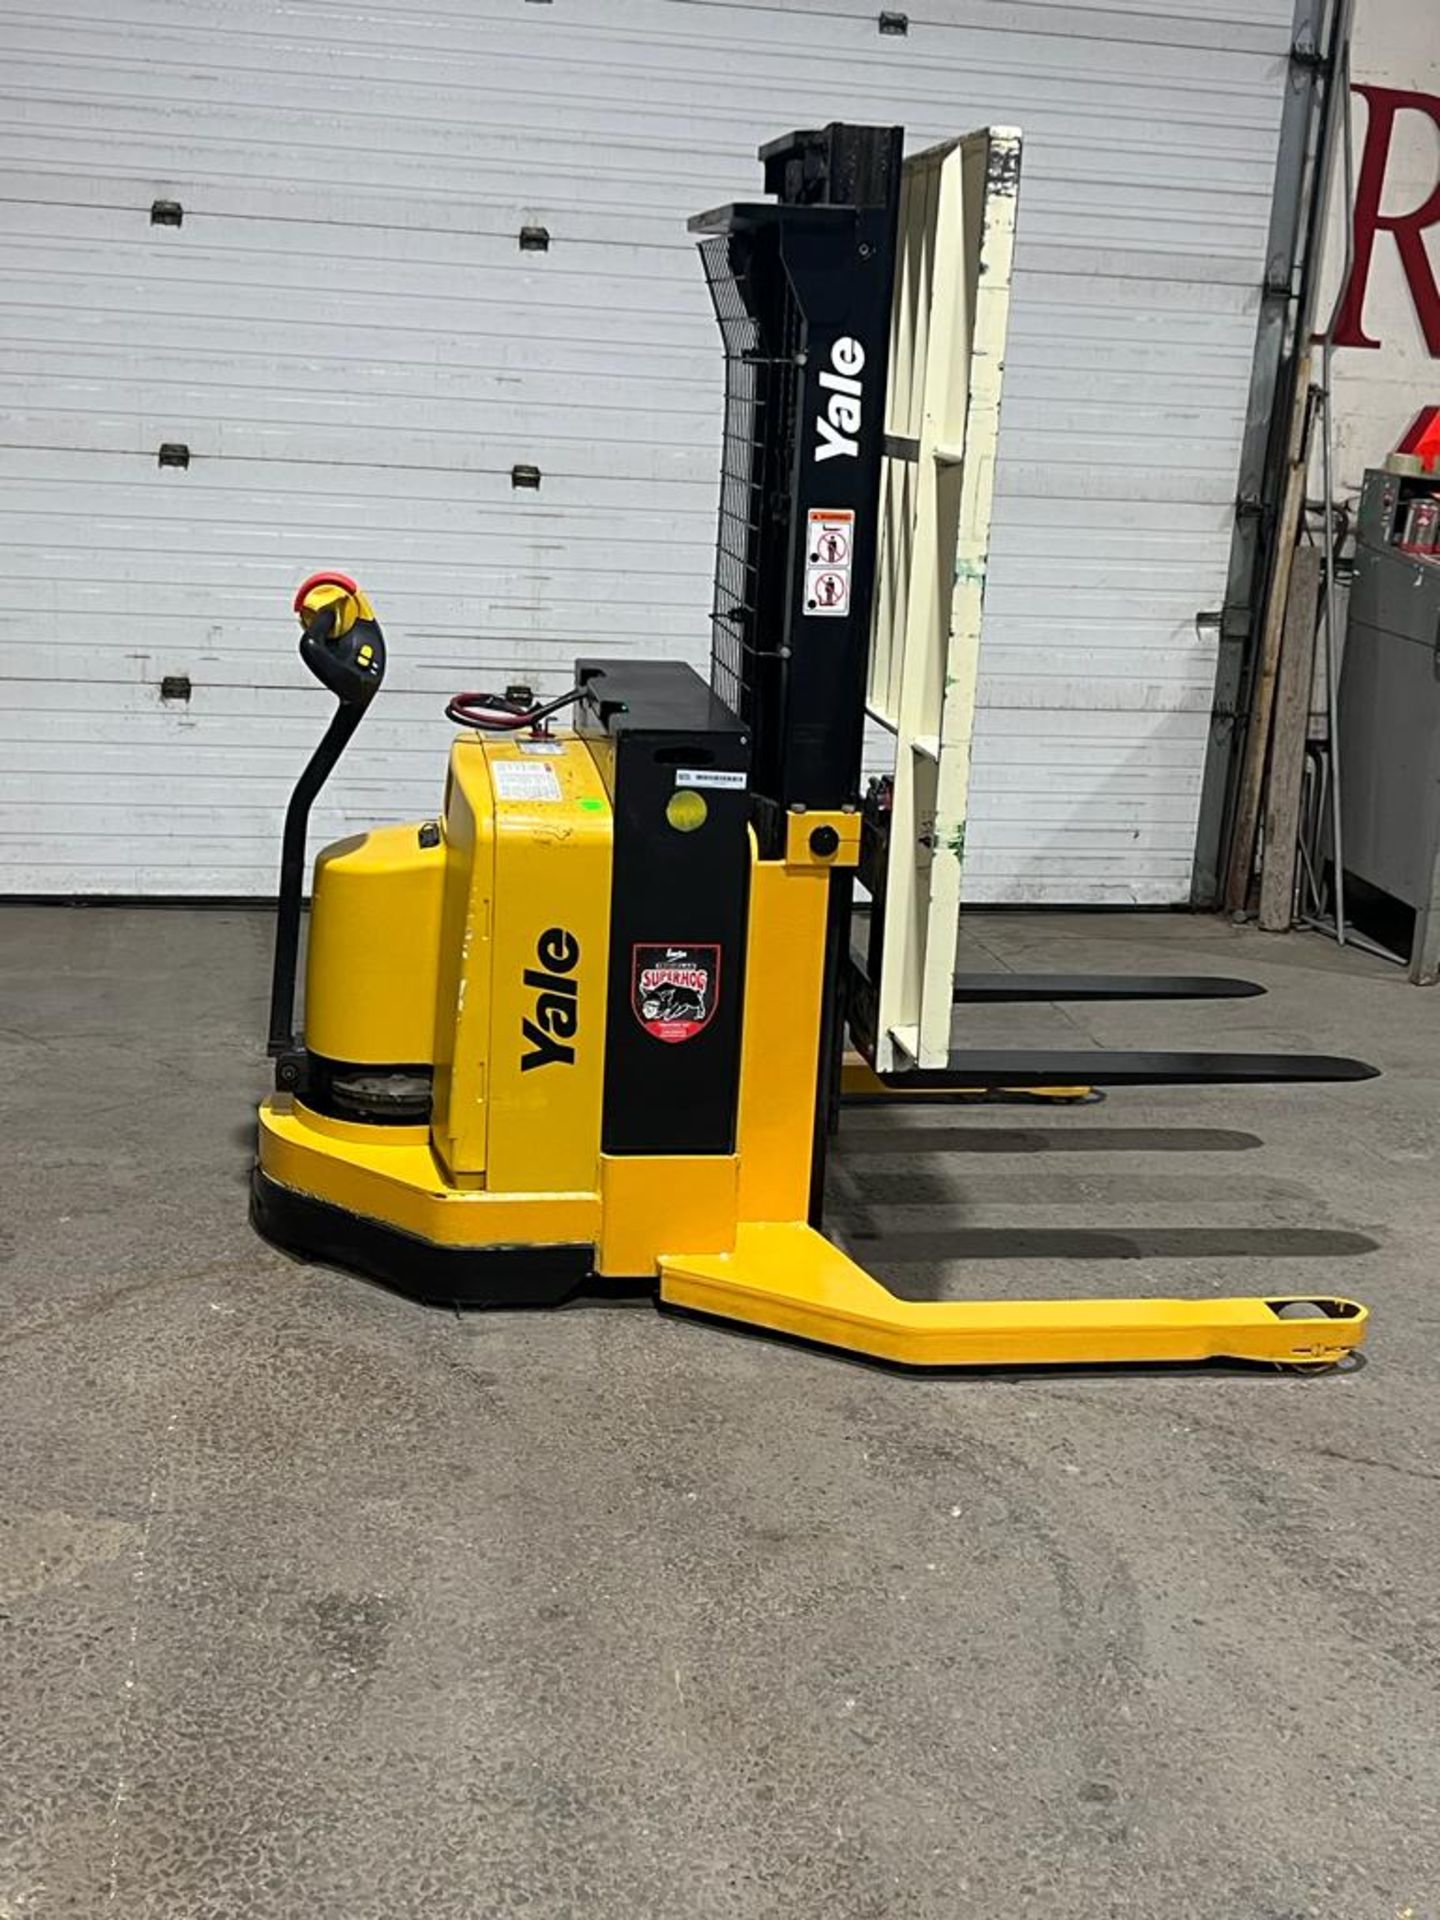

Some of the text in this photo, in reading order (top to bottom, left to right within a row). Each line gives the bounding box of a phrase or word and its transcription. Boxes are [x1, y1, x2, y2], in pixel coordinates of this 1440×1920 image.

[814, 336, 865, 462] Yale
[521, 928, 579, 1072] Yale
[641, 969, 708, 991] SUPERHOG
